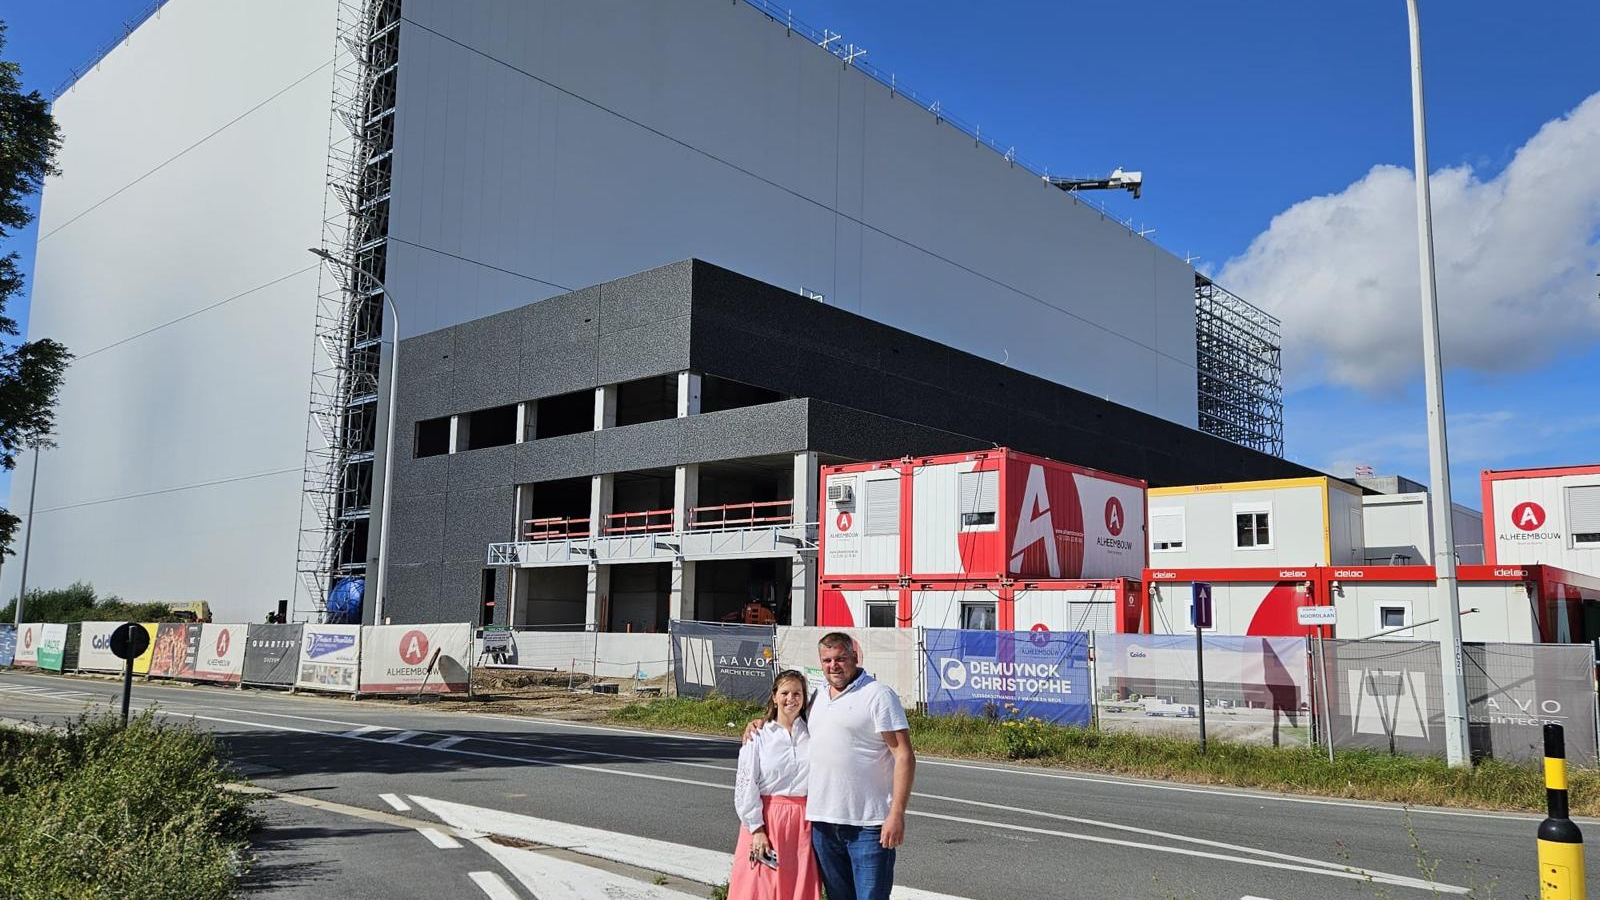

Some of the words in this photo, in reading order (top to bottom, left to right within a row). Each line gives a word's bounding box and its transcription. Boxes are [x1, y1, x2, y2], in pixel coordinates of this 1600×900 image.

[92, 634, 111, 650] Cold
[720, 668, 766, 677] ARCHITECTS
[970, 661, 1060, 678] DEMUYNCK
[970, 676, 1072, 694] CHRISTOPHE
